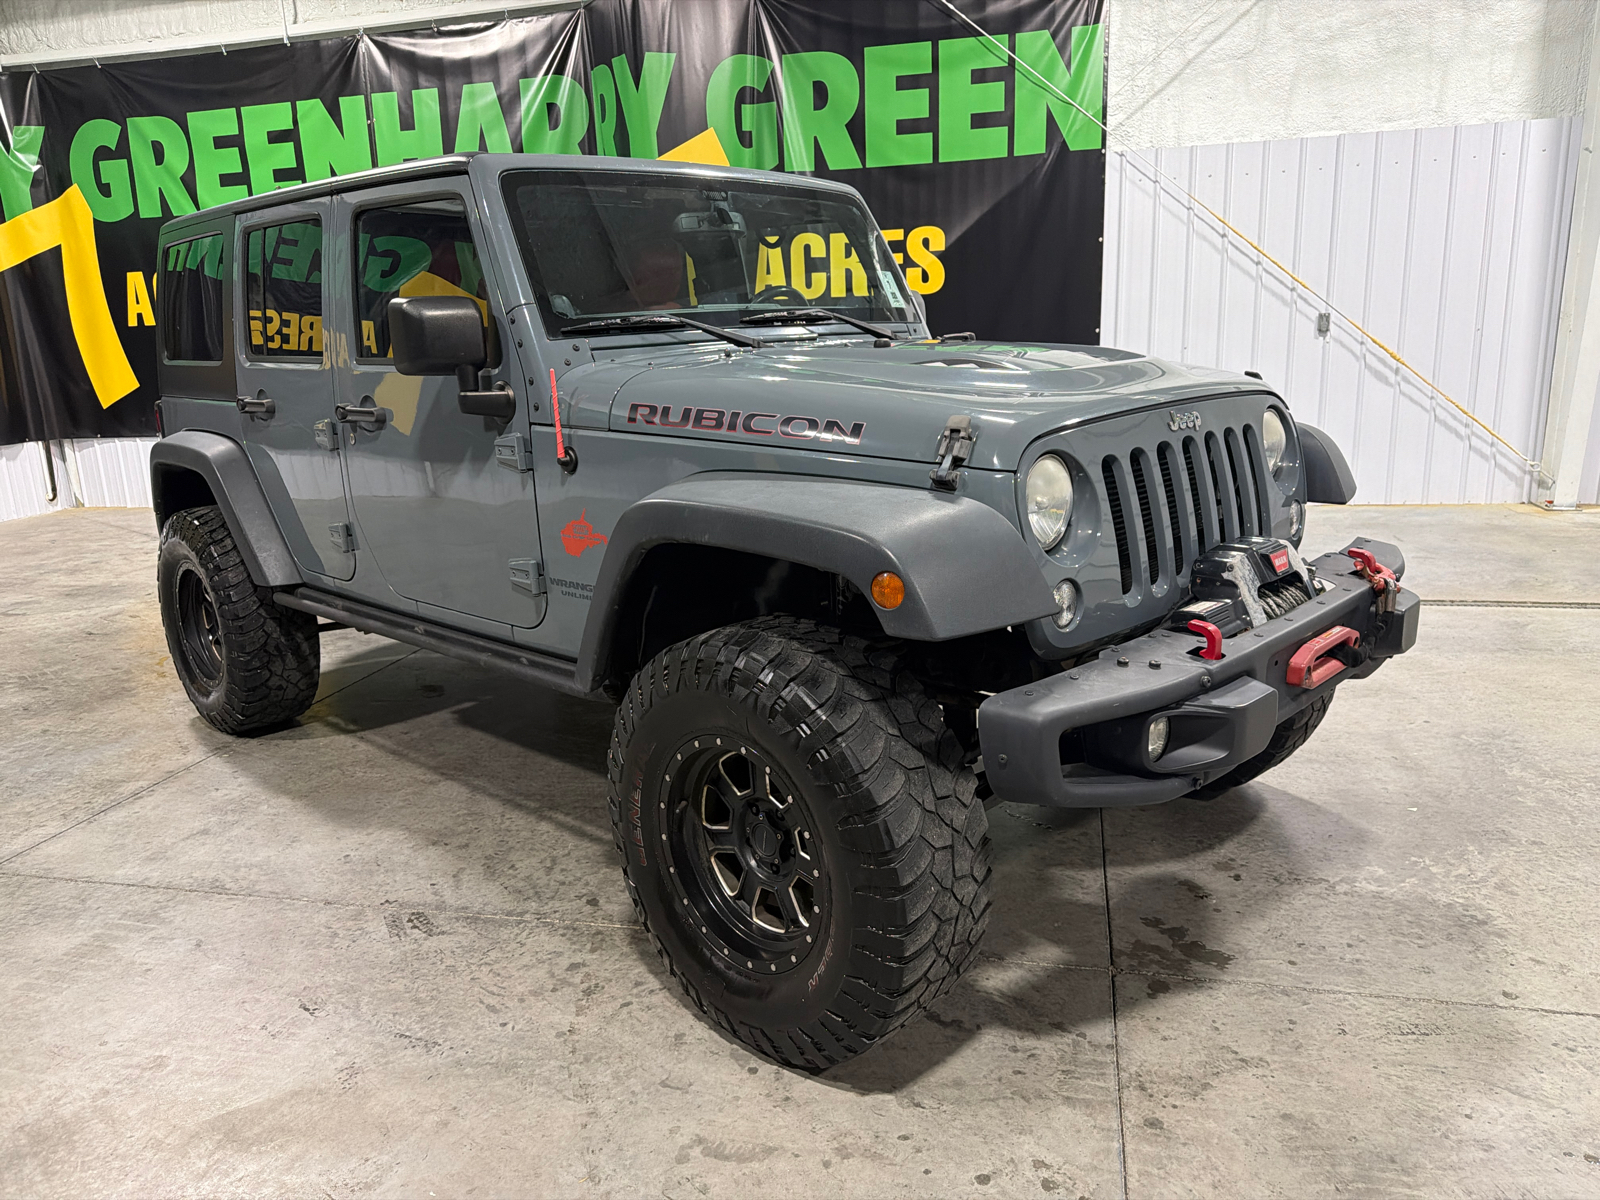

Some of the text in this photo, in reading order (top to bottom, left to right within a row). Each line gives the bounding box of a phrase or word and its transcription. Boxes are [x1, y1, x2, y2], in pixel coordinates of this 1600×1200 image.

[706, 24, 1106, 172] GREEN
[627, 402, 866, 445] RUBICON
[1167, 410, 1201, 431] Jeep
[549, 577, 594, 593] WRANG
